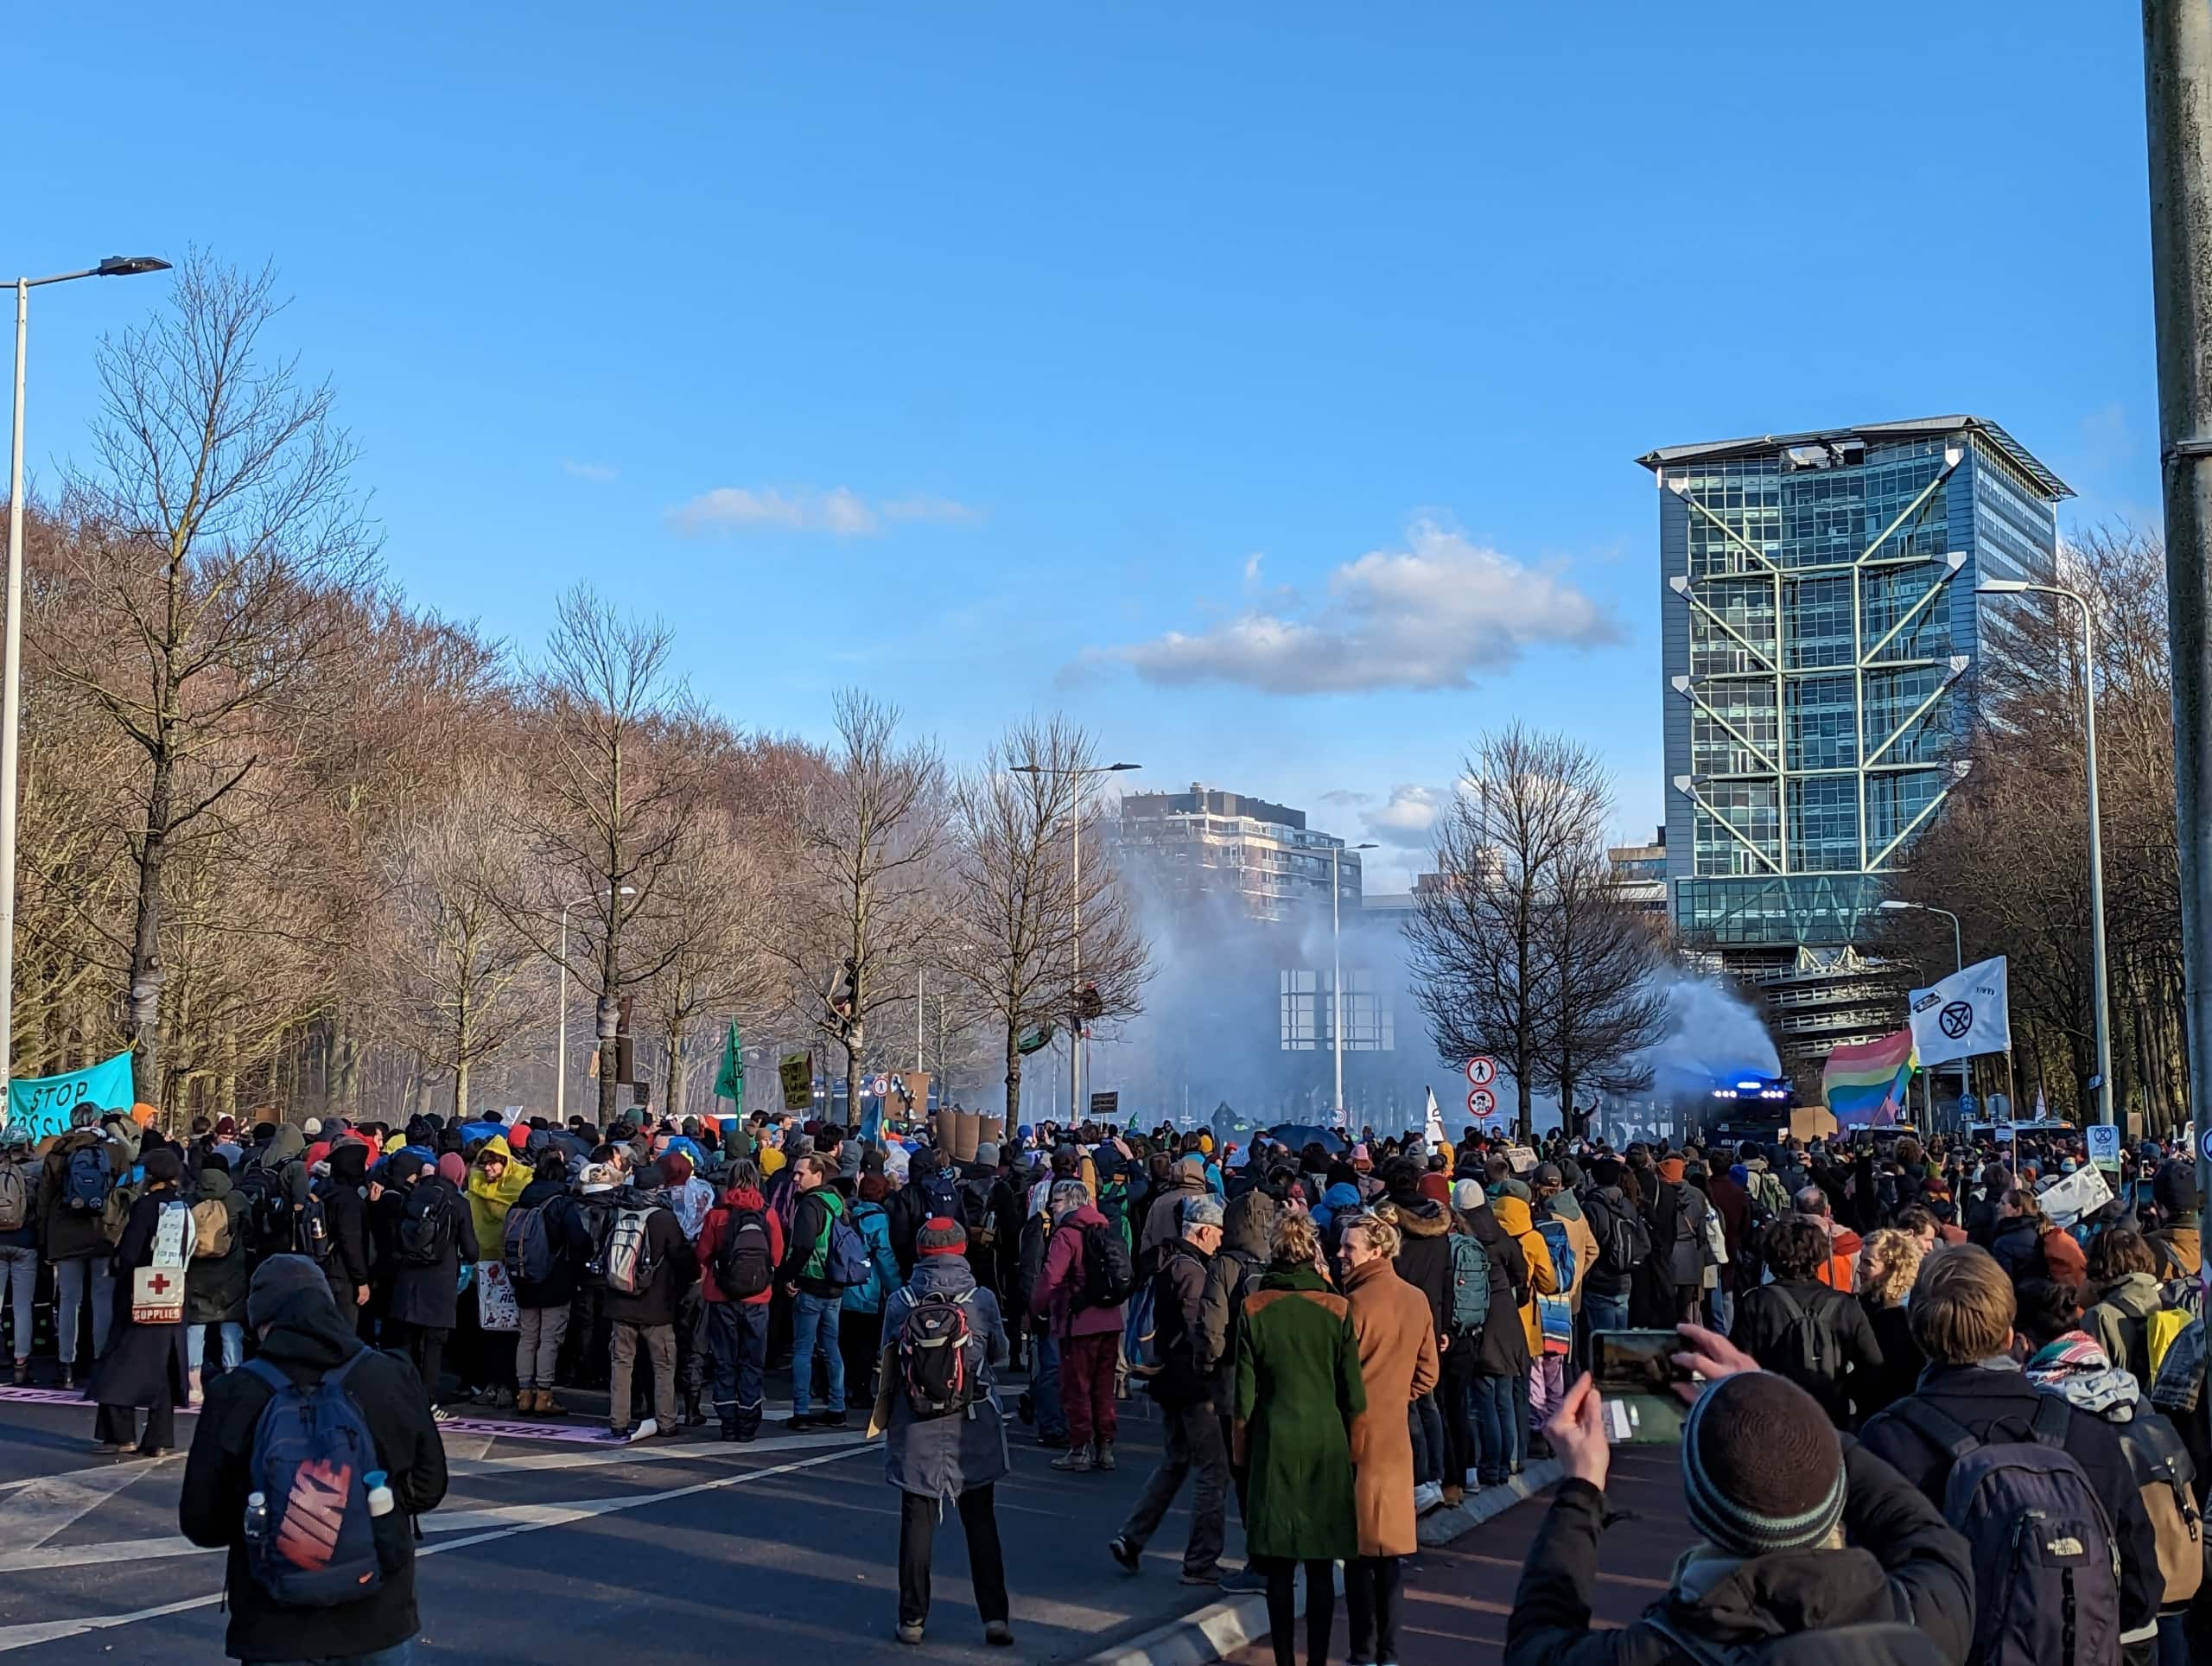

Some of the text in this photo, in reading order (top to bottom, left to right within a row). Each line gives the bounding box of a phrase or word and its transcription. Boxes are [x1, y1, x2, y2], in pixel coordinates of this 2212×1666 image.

[30, 1082, 88, 1112] STOP
[133, 1308, 181, 1320] SUPPLIES
[276, 1458, 352, 1570] NIKE
